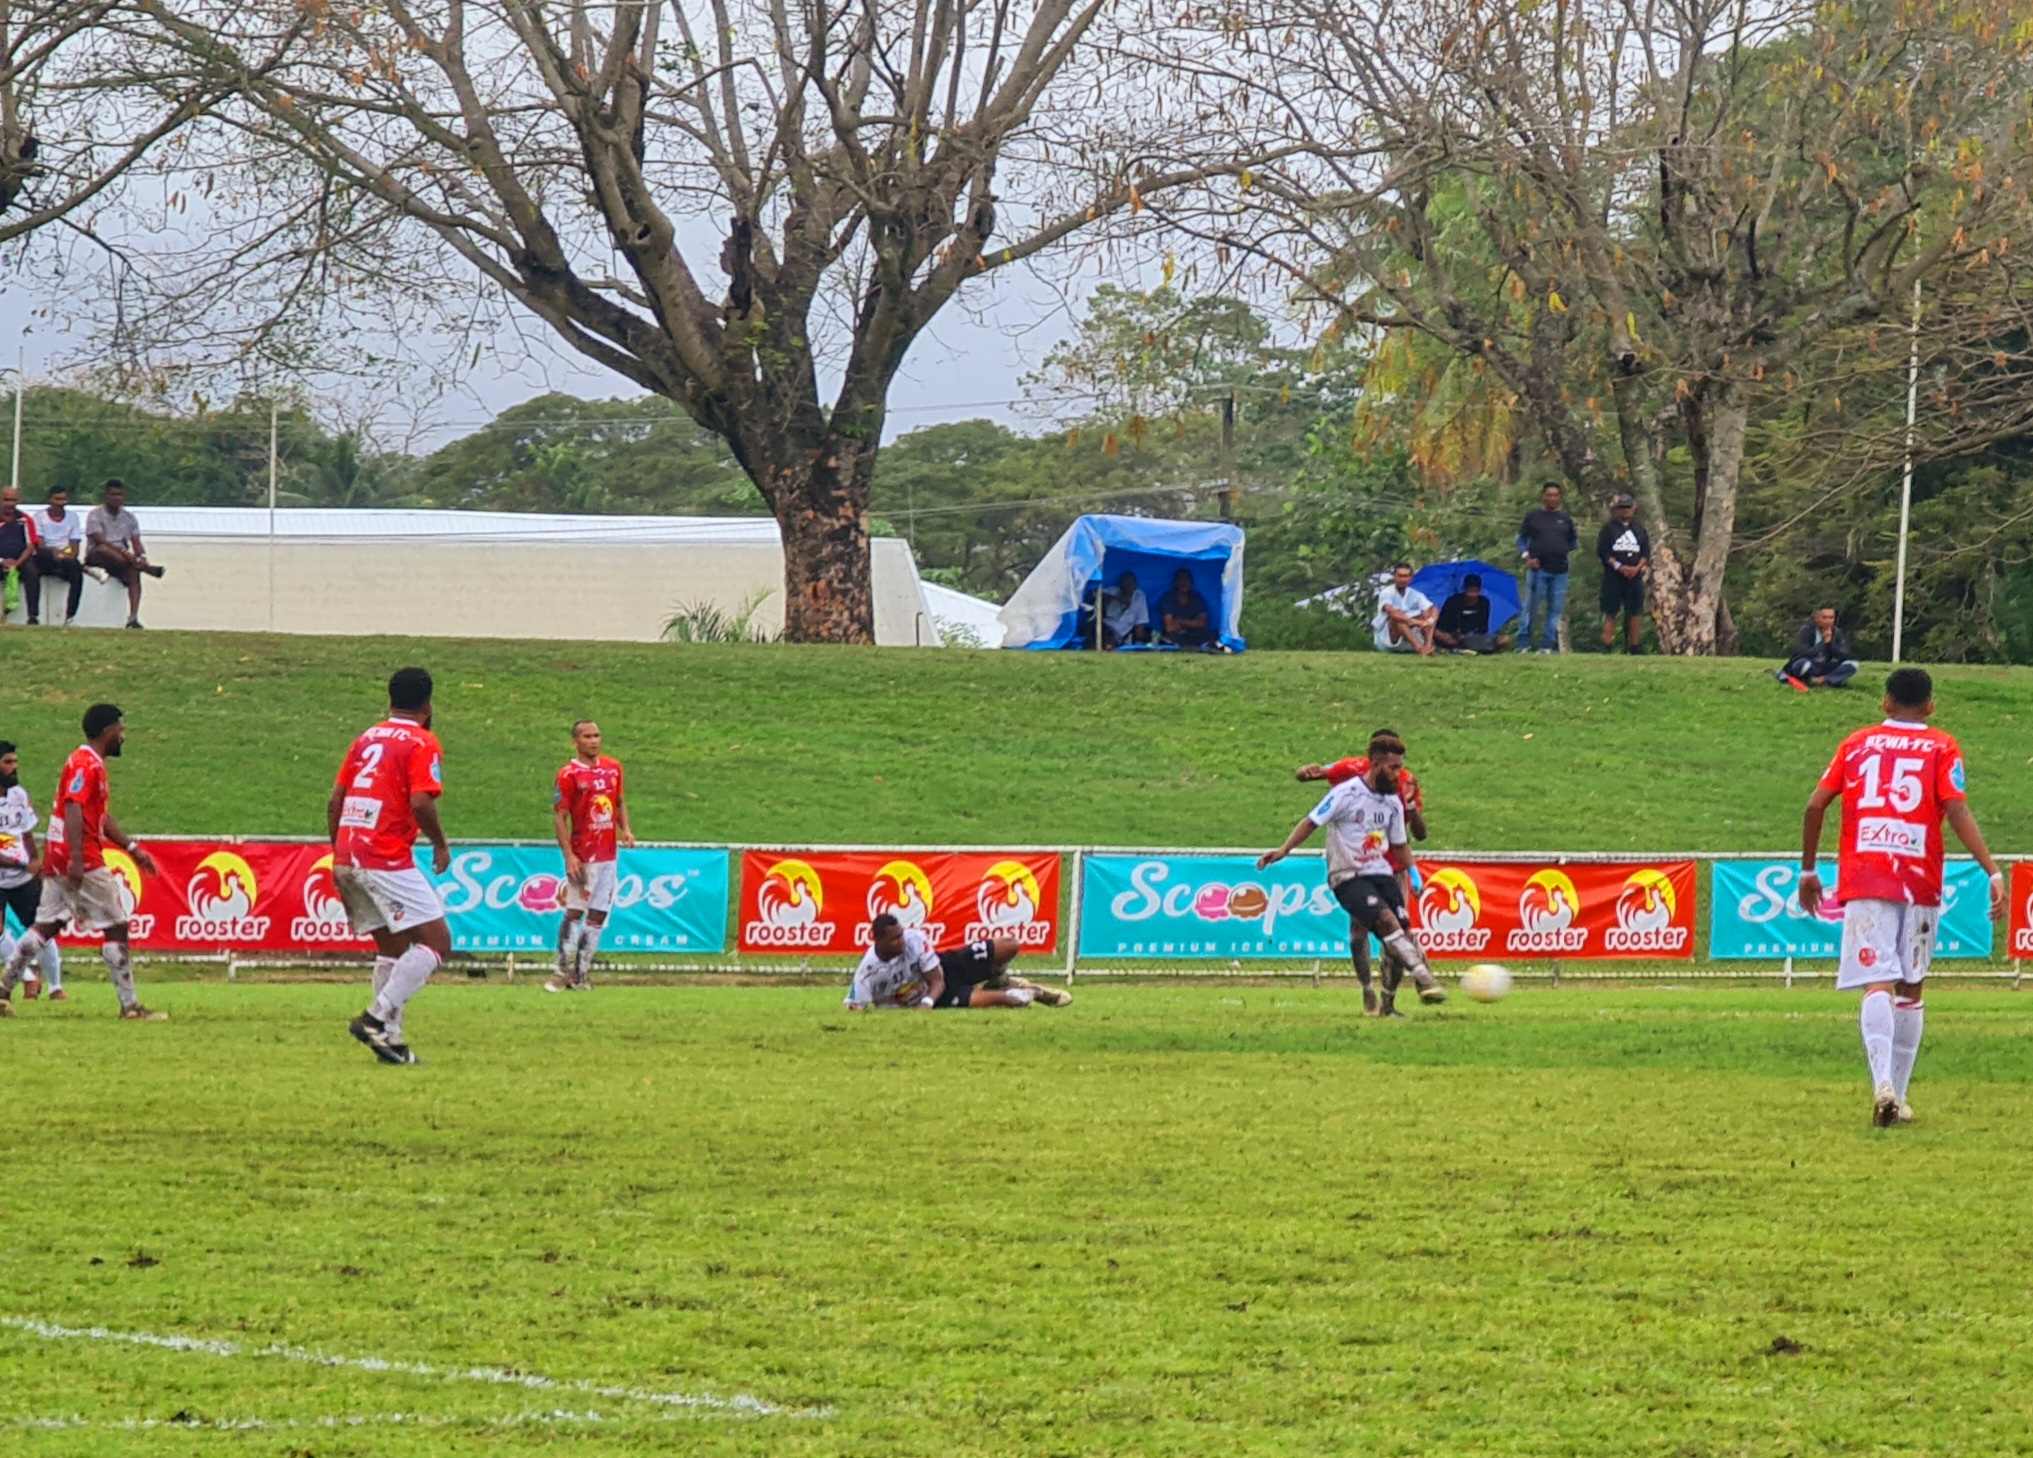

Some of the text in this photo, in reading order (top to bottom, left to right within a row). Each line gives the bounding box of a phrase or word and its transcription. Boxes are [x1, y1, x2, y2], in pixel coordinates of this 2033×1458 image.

[353, 743, 383, 788] 2
[1857, 754, 1925, 813] 15
[1373, 811, 1385, 824] 10
[177, 916, 269, 939] rooster
[748, 922, 834, 943] rooster
[1606, 927, 1686, 948] rooster
[457, 935, 544, 946] REMIUM
[614, 935, 688, 946] CREAM
[1117, 941, 1346, 953] PREMIUM ICE CREAM
[1508, 928, 1587, 948] rooster
[1744, 942, 1835, 954] PREMIUM
